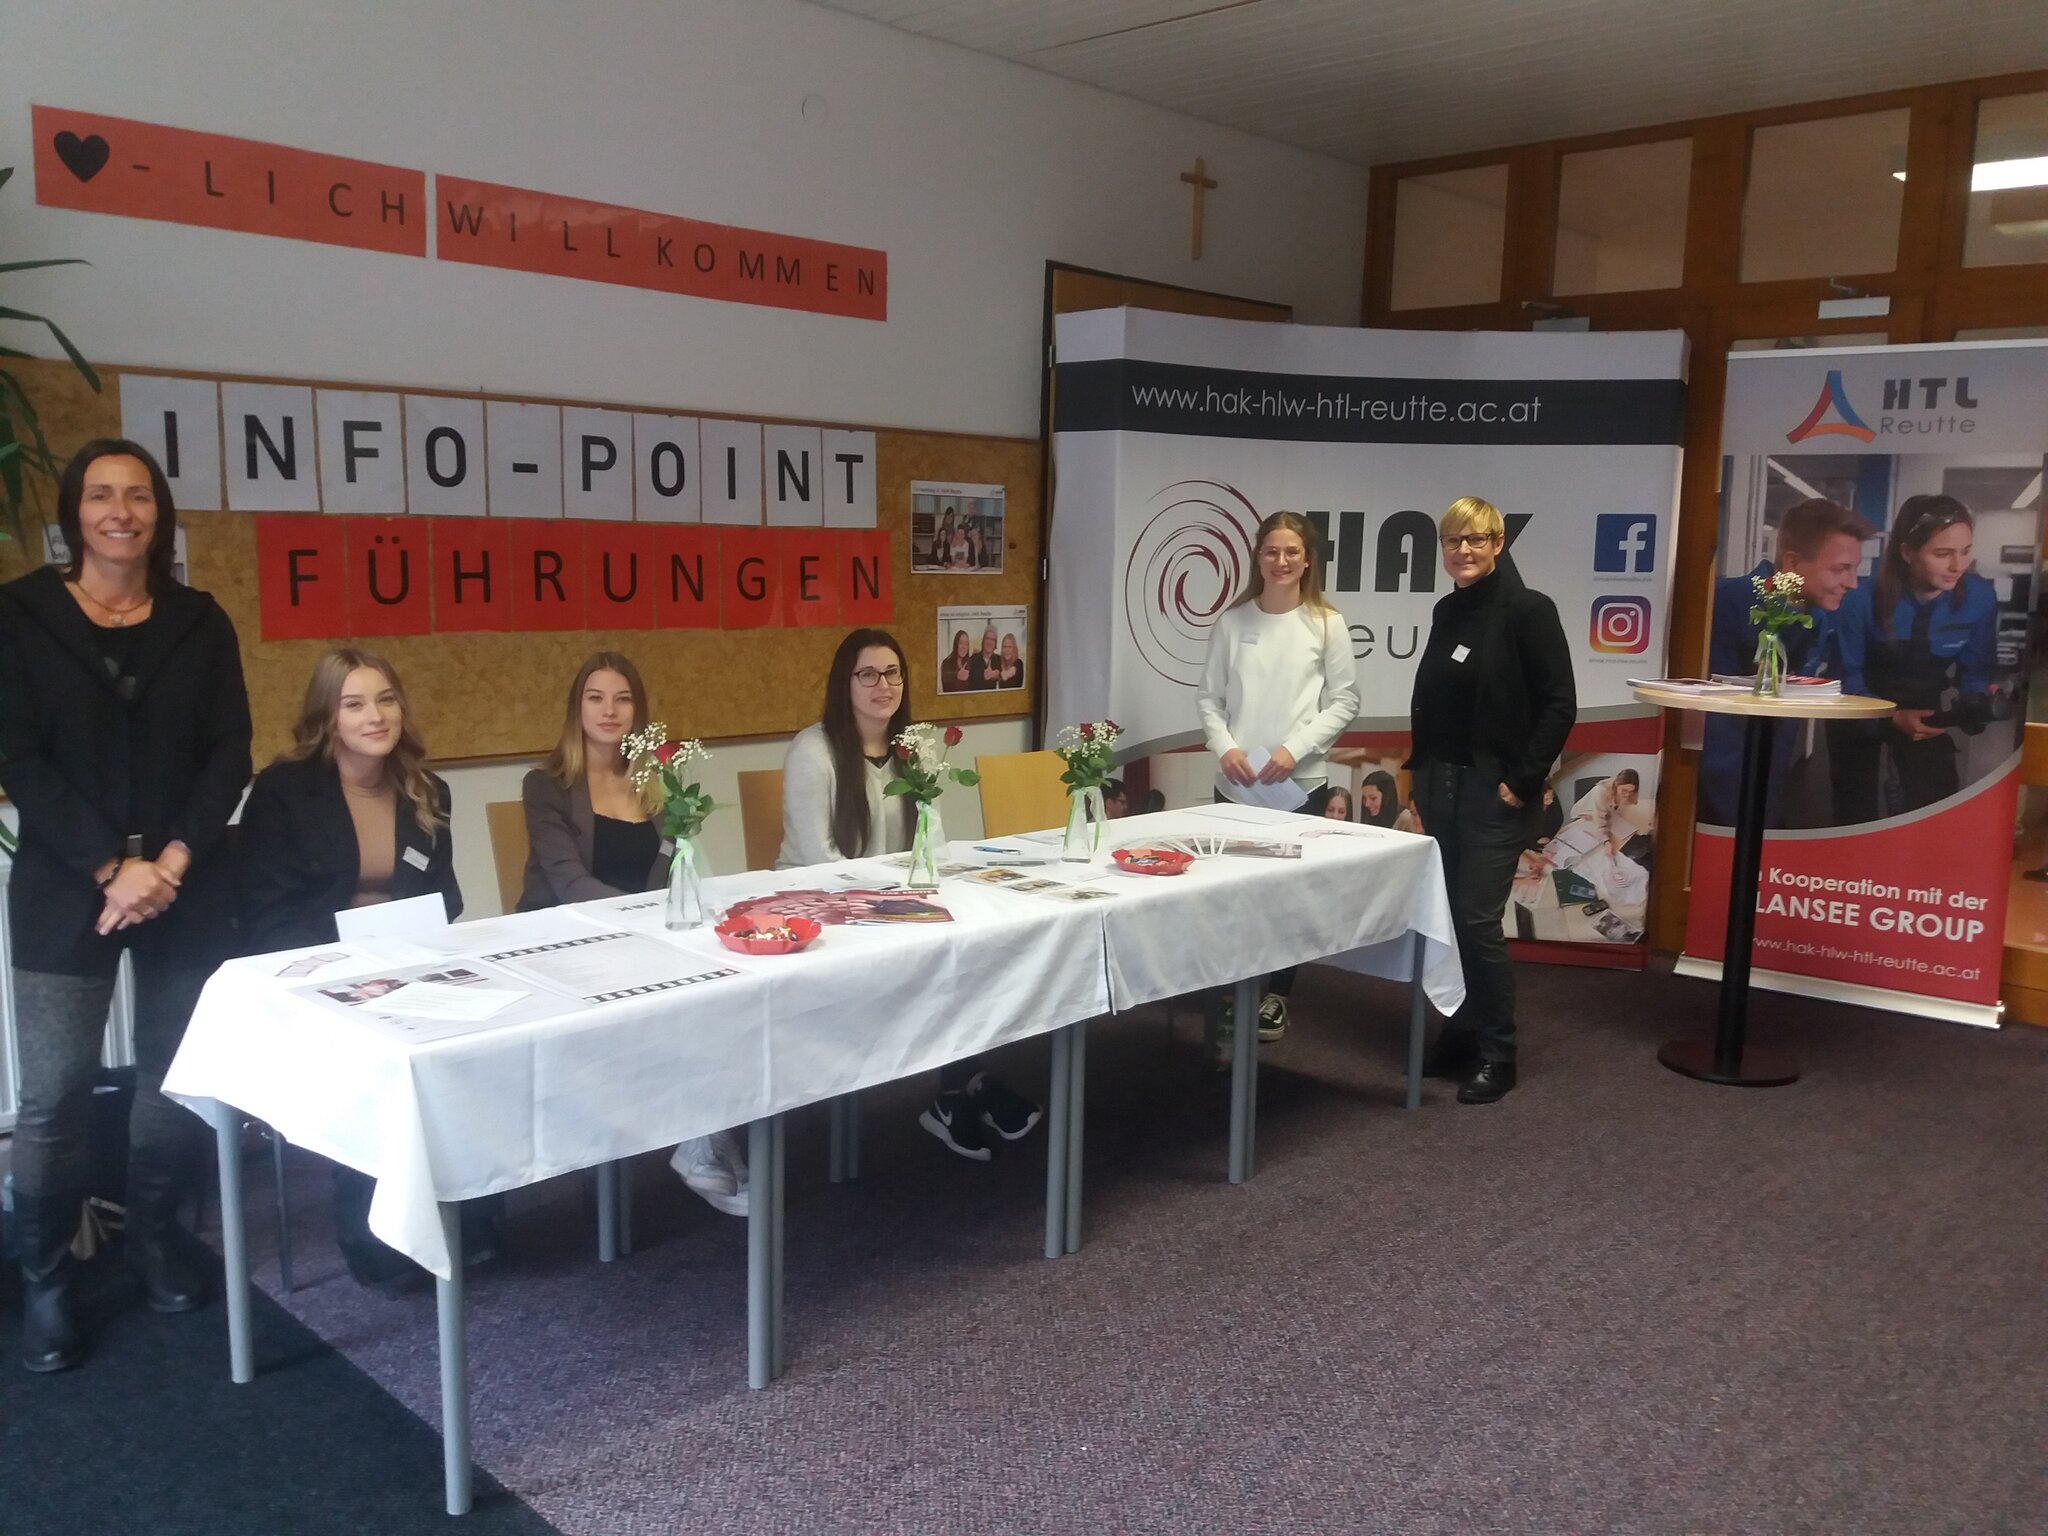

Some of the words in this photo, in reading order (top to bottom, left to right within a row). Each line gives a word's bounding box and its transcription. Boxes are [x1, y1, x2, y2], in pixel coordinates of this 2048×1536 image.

[448, 201, 876, 296] WILLKOMMEN
[1131, 384, 1542, 423] www.hak-hlw-htl-reutte.ac.at
[1882, 376, 1978, 410] HTL
[1879, 415, 1977, 435] Reutte
[164, 410, 864, 504] INFO-POINT
[288, 535, 882, 607] FÜHRUNGEN
[1768, 866, 1901, 900] Kooperation
[1906, 886, 1943, 905] mit
[1947, 890, 1989, 911] der
[1755, 890, 1861, 927] LANSEE
[1868, 906, 1985, 943] GROUP
[1752, 937, 1981, 981] ww.hak-hlw-htl-reutte.ac.at
